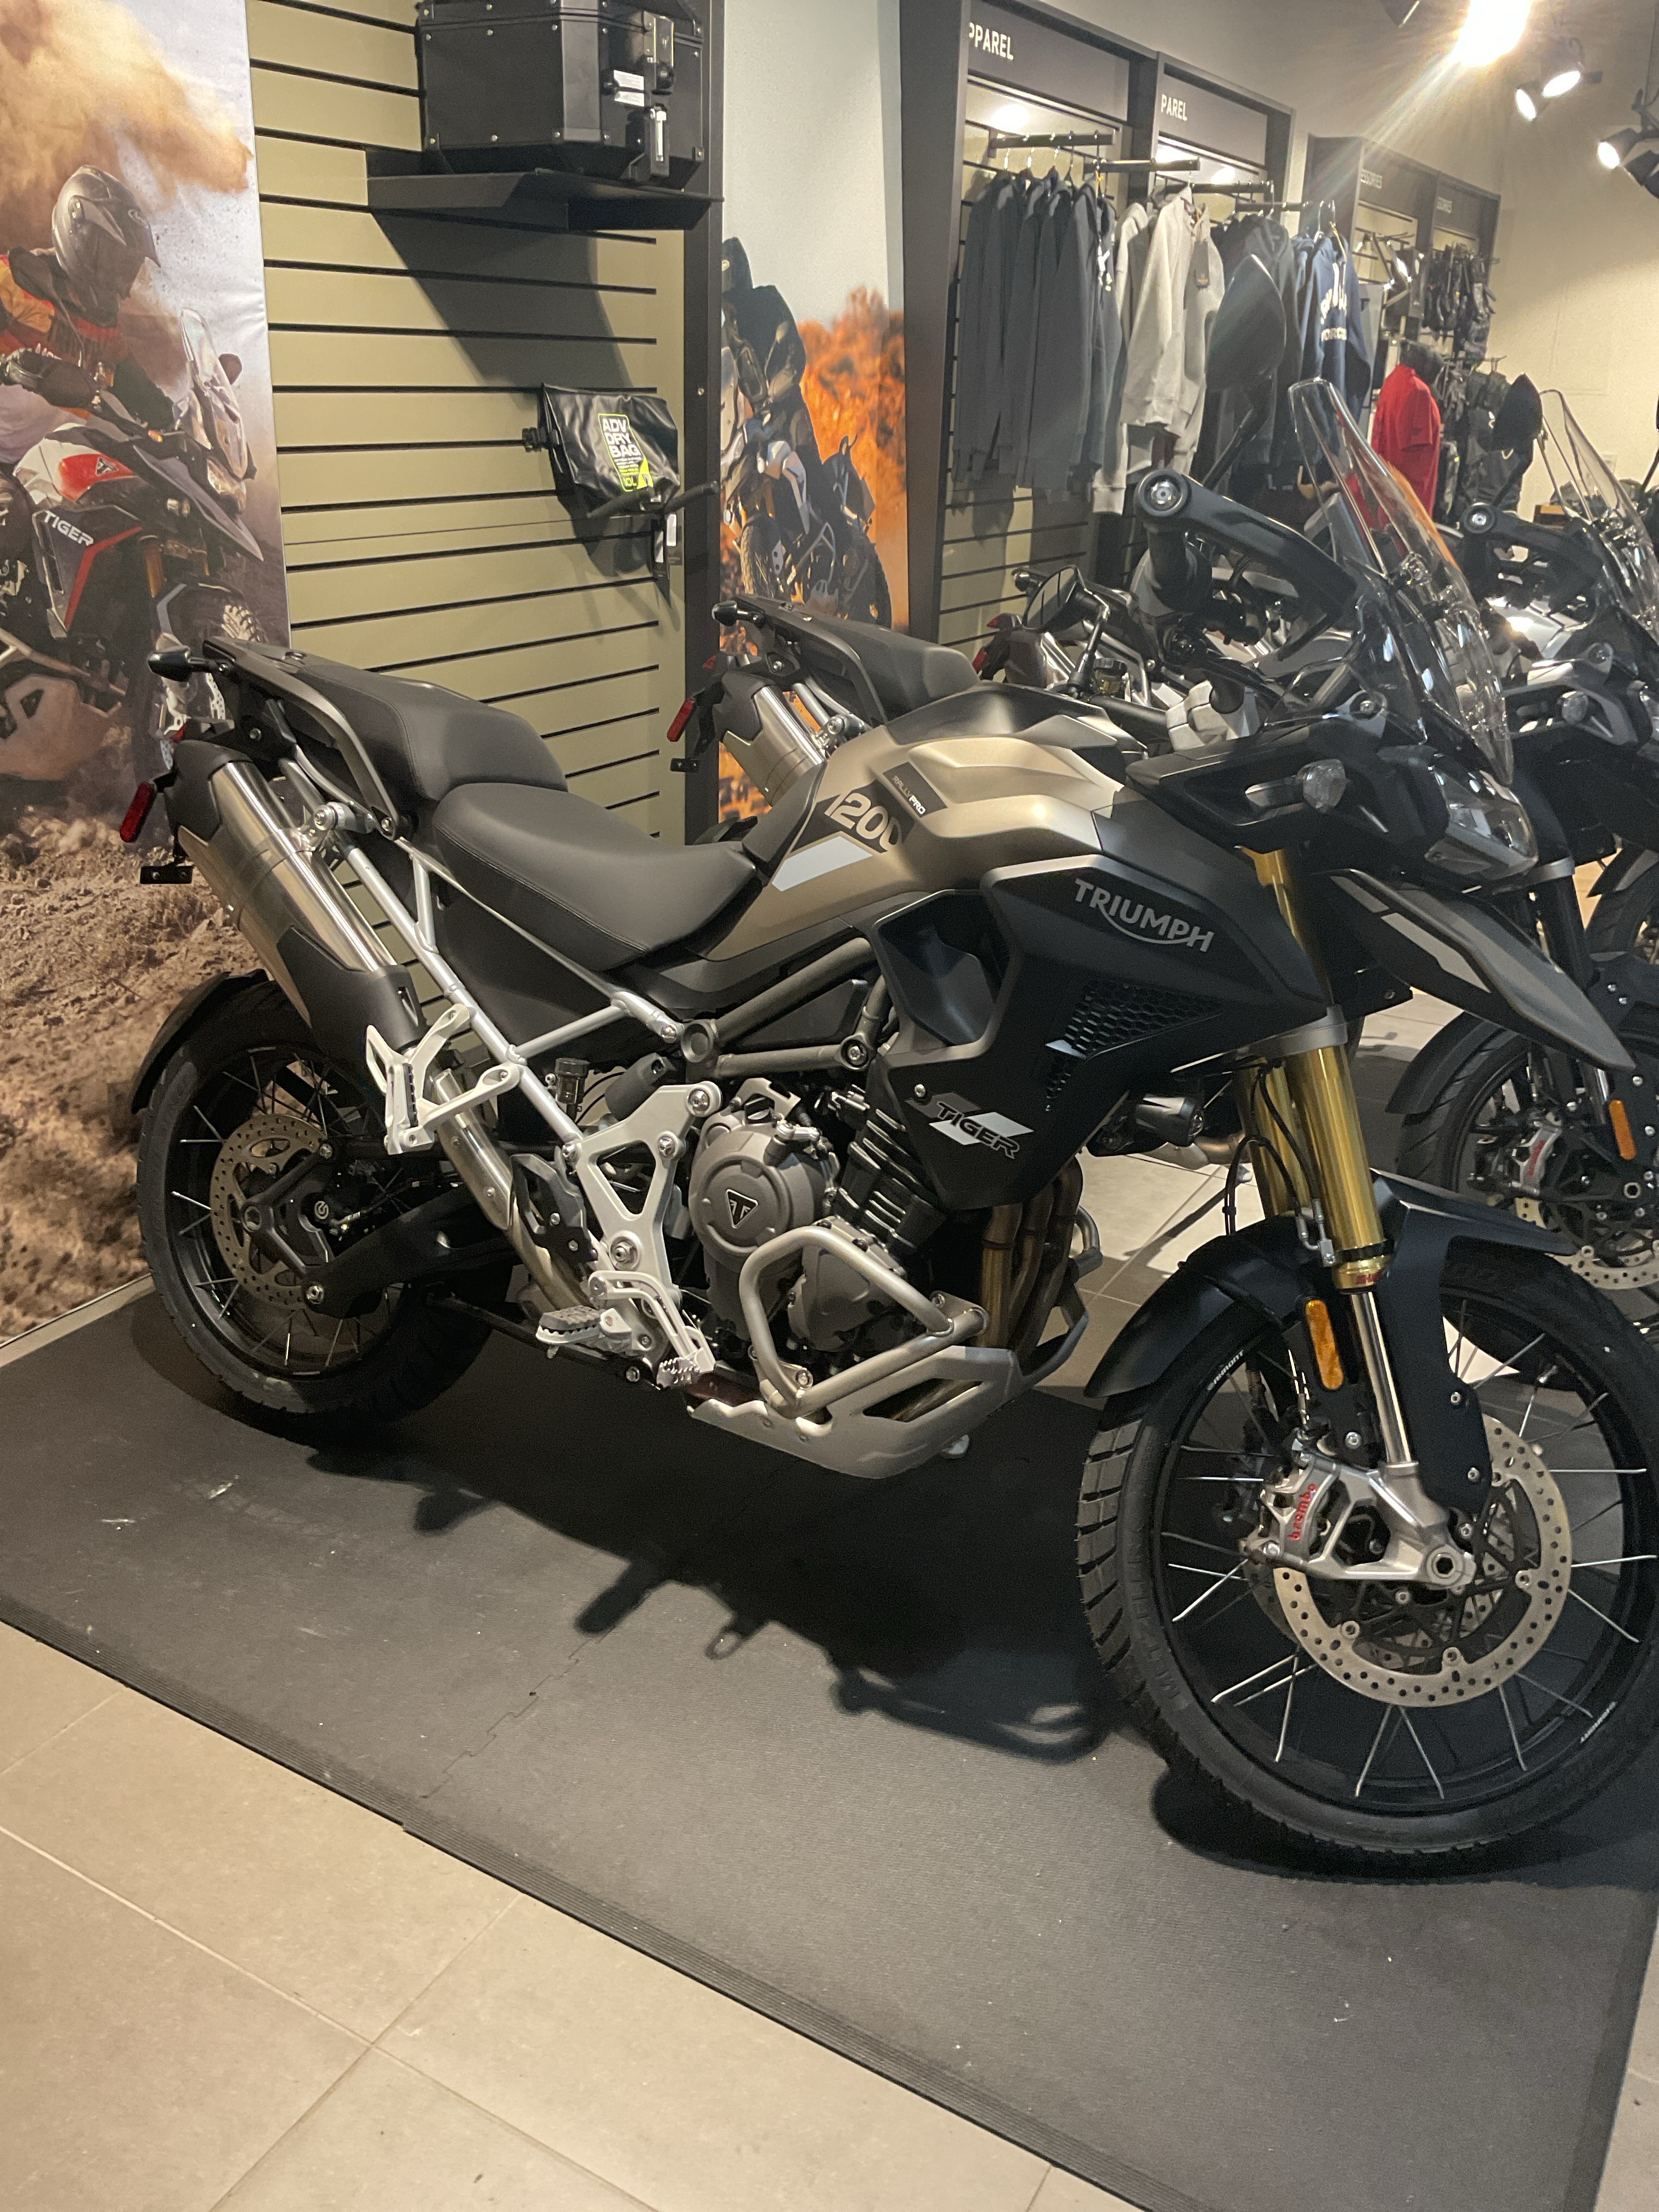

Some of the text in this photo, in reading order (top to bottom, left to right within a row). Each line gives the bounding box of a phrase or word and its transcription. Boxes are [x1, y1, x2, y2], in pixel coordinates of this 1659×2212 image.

[1161, 94, 1188, 121] PAREL
[602, 419, 627, 432] ADV
[604, 432, 631, 445] DRY
[608, 444, 641, 458] BAG
[44, 510, 94, 546] TIGER
[1075, 878, 1215, 952] TRIUMPH
[936, 1101, 1020, 1159] TIGER
[1286, 1483, 1317, 1541] brembo
